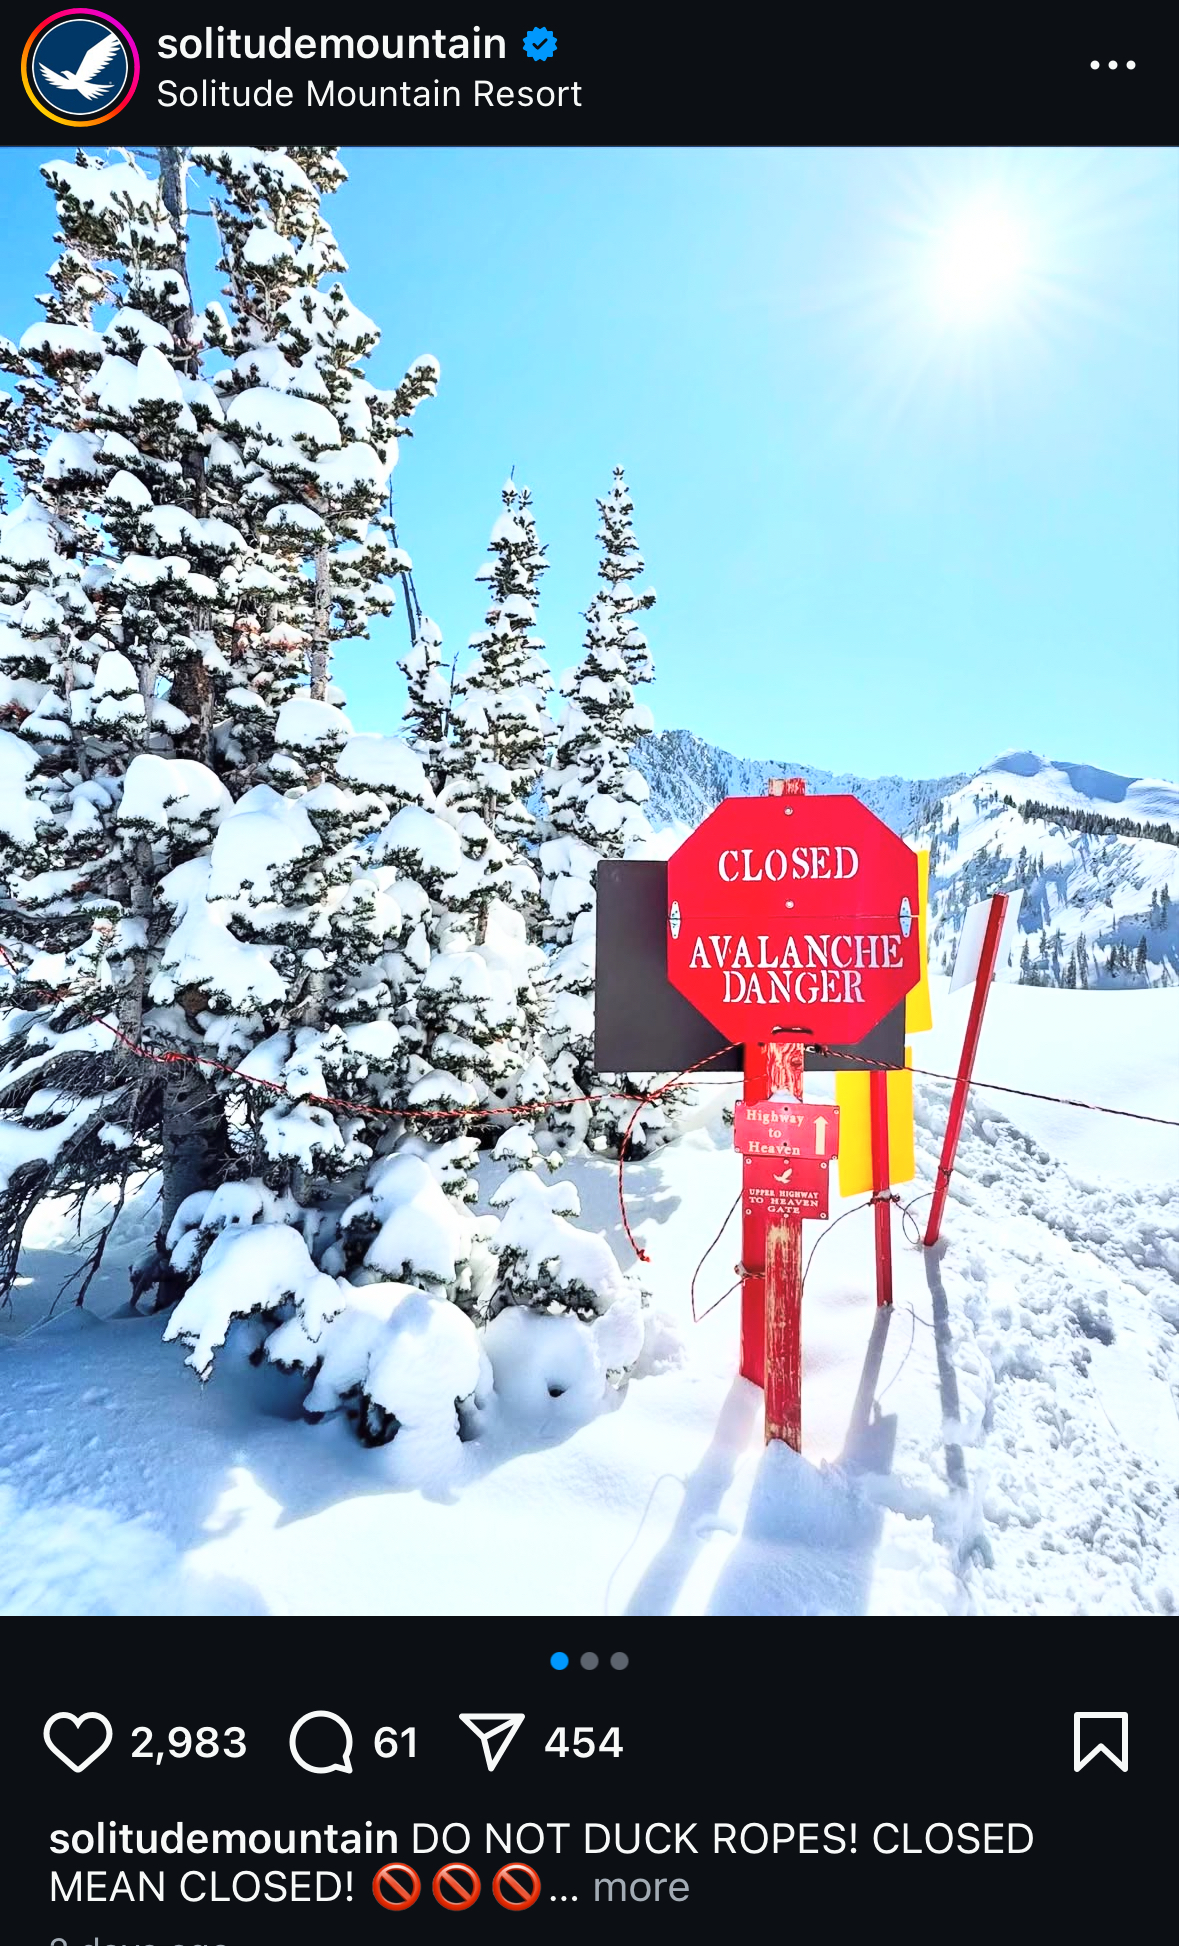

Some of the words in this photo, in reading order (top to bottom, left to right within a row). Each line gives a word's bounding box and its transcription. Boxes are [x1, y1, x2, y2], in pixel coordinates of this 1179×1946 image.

[718, 847, 859, 882] CLOSED
[689, 934, 904, 969] AVALANCHE
[722, 970, 866, 1004] DANGER
[746, 1109, 804, 1127] Highway
[768, 1128, 782, 1138] to
[748, 1141, 801, 1155] Heaven
[749, 1188, 775, 1197] UPPER
[779, 1190, 819, 1199] HIGHWAY
[767, 1205, 800, 1214] GATE
[770, 1198, 819, 1207] HEAVEN
